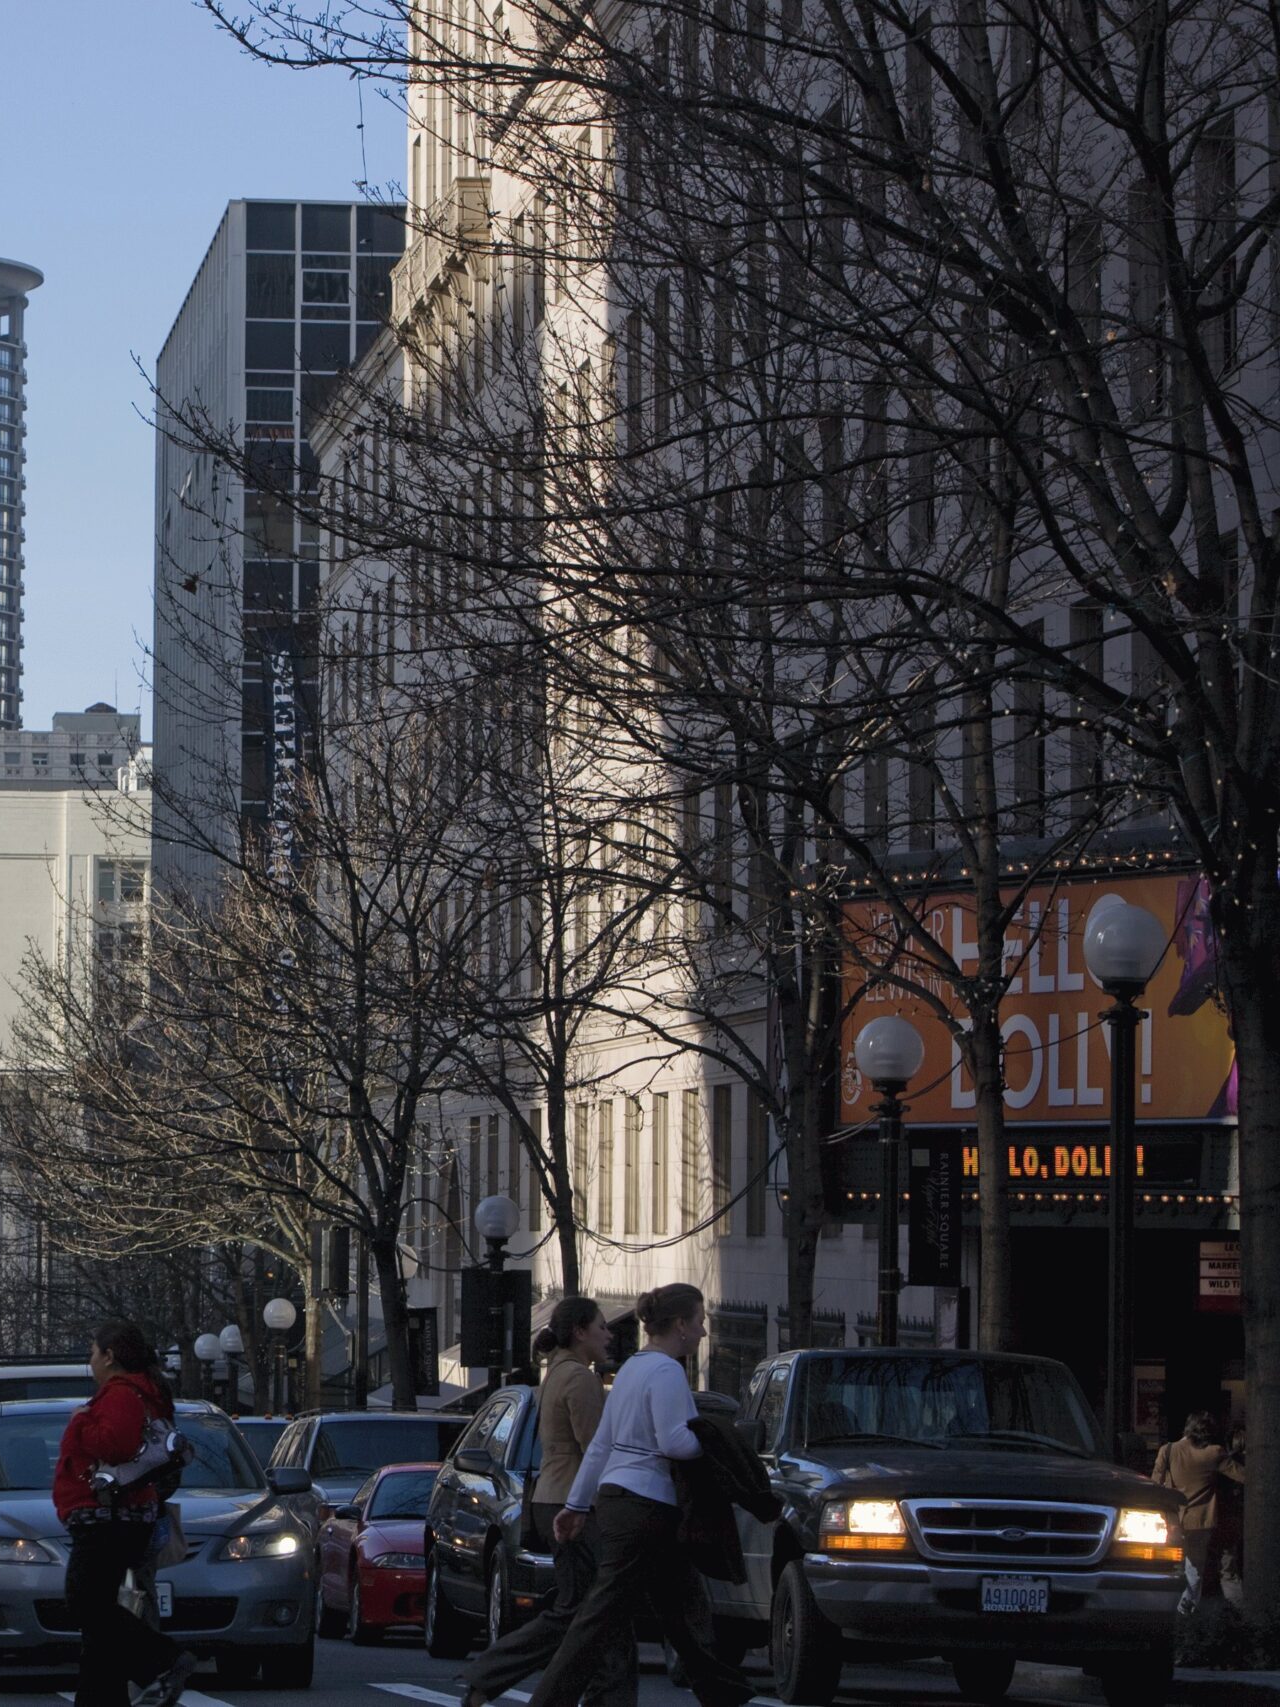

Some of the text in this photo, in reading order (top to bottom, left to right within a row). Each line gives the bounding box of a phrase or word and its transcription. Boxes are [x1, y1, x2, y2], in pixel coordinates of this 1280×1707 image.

[962, 1145, 1144, 1179] HLO, DOLL!
[939, 1152, 949, 1269] RAINIER SQUARE
[1208, 1280, 1230, 1288] WILD
[983, 1588, 1047, 1606] A91008P
